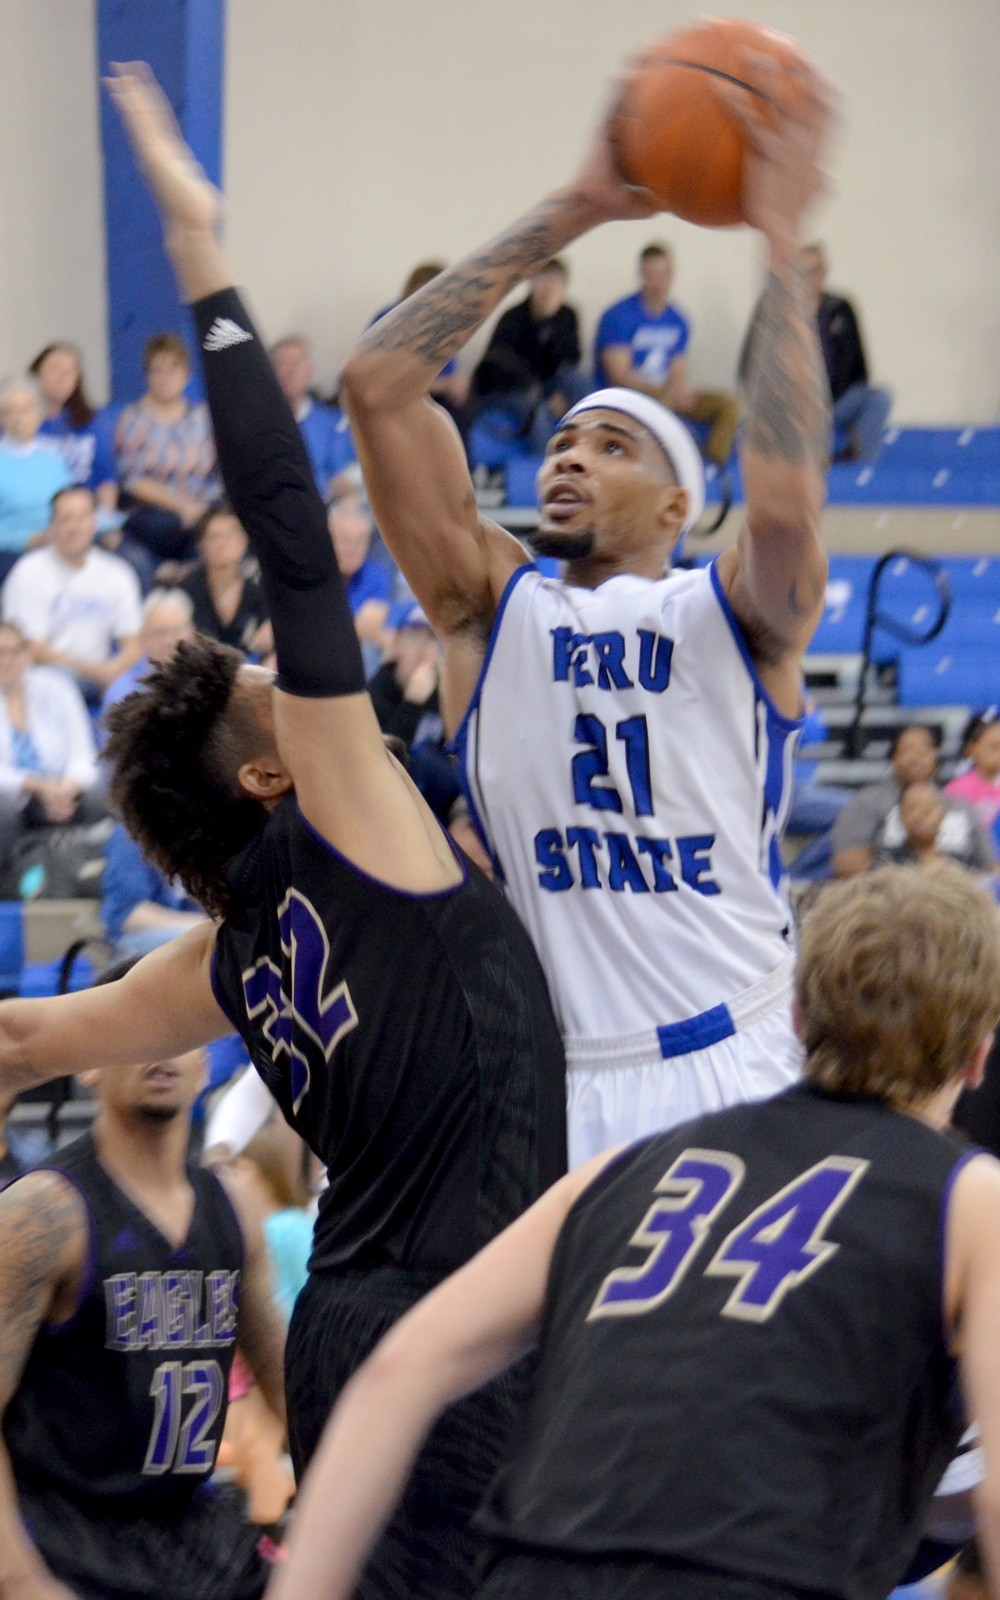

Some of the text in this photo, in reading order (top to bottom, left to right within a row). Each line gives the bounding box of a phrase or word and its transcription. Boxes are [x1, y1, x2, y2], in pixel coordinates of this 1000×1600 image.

[571, 713, 655, 818] 21
[534, 827, 721, 896] STATE
[242, 887, 359, 1116] 32
[585, 1148, 871, 1323] 34
[141, 1360, 224, 1475] 12
